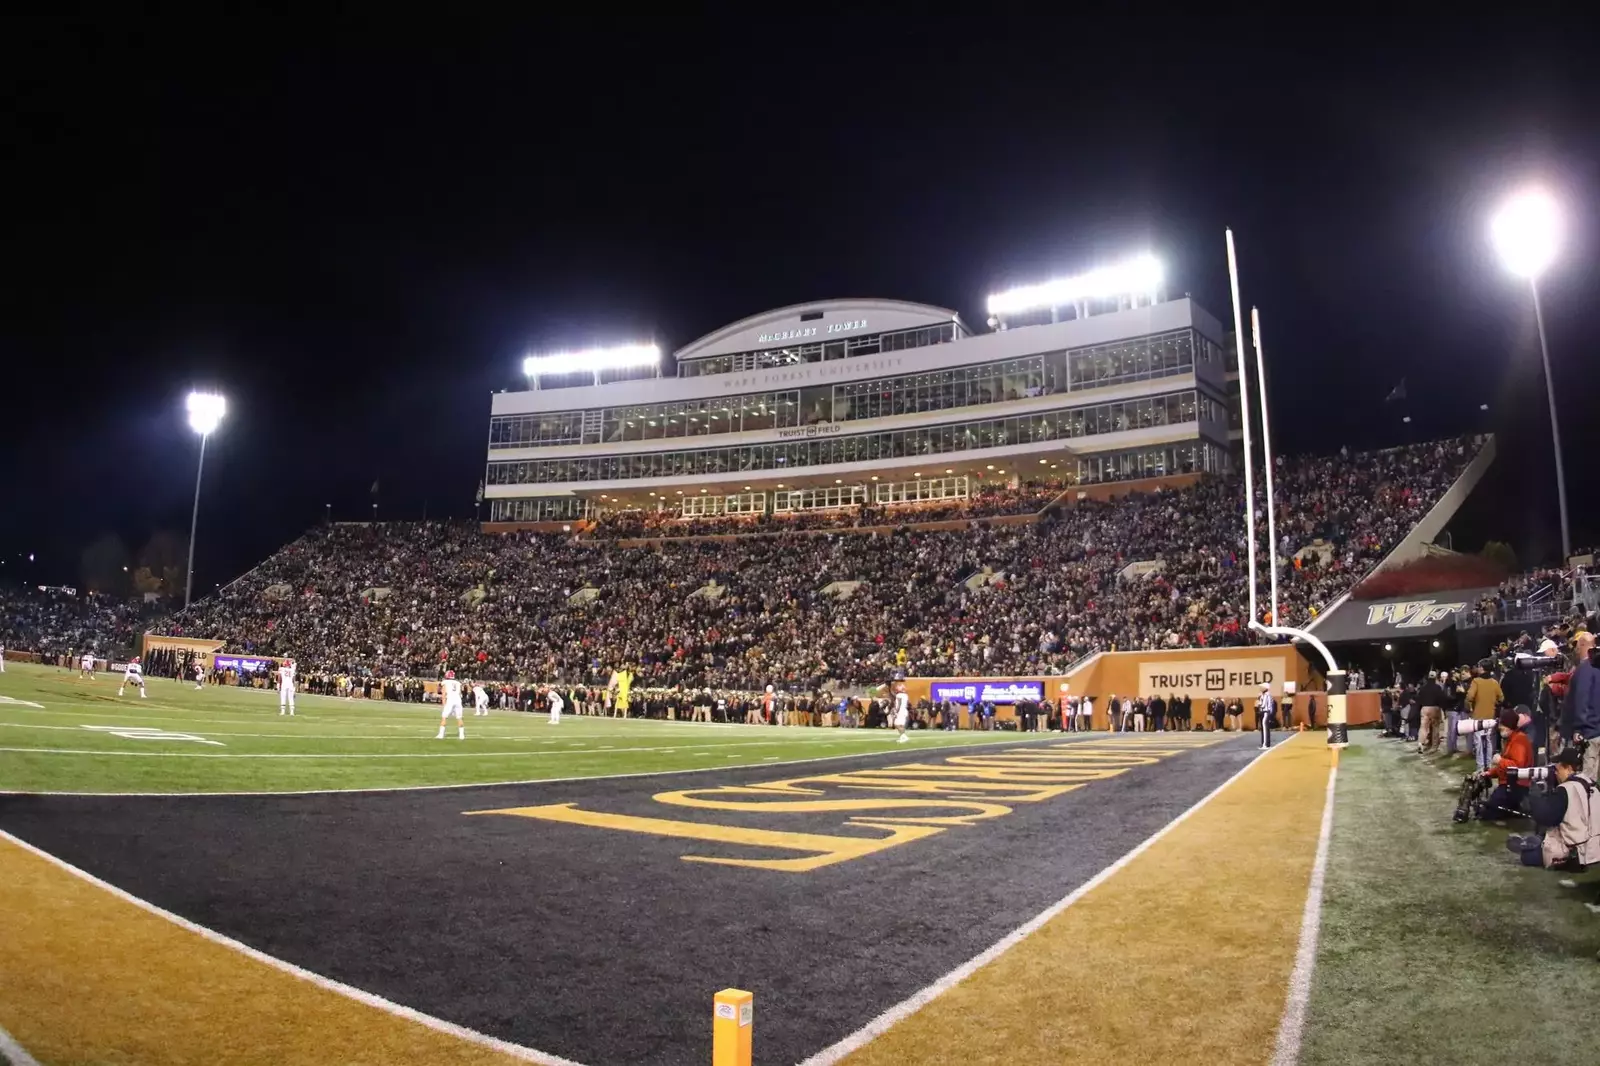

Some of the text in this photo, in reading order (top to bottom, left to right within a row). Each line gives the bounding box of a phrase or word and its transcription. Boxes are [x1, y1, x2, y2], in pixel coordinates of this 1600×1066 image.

[826, 319, 868, 333] TOWER
[765, 370, 812, 383] FOREST
[819, 358, 904, 377] UNIVERSITY
[779, 425, 840, 437] TRUIST FIELD
[1366, 600, 1467, 628] WF
[1150, 671, 1274, 688] TRUIST FIELD
